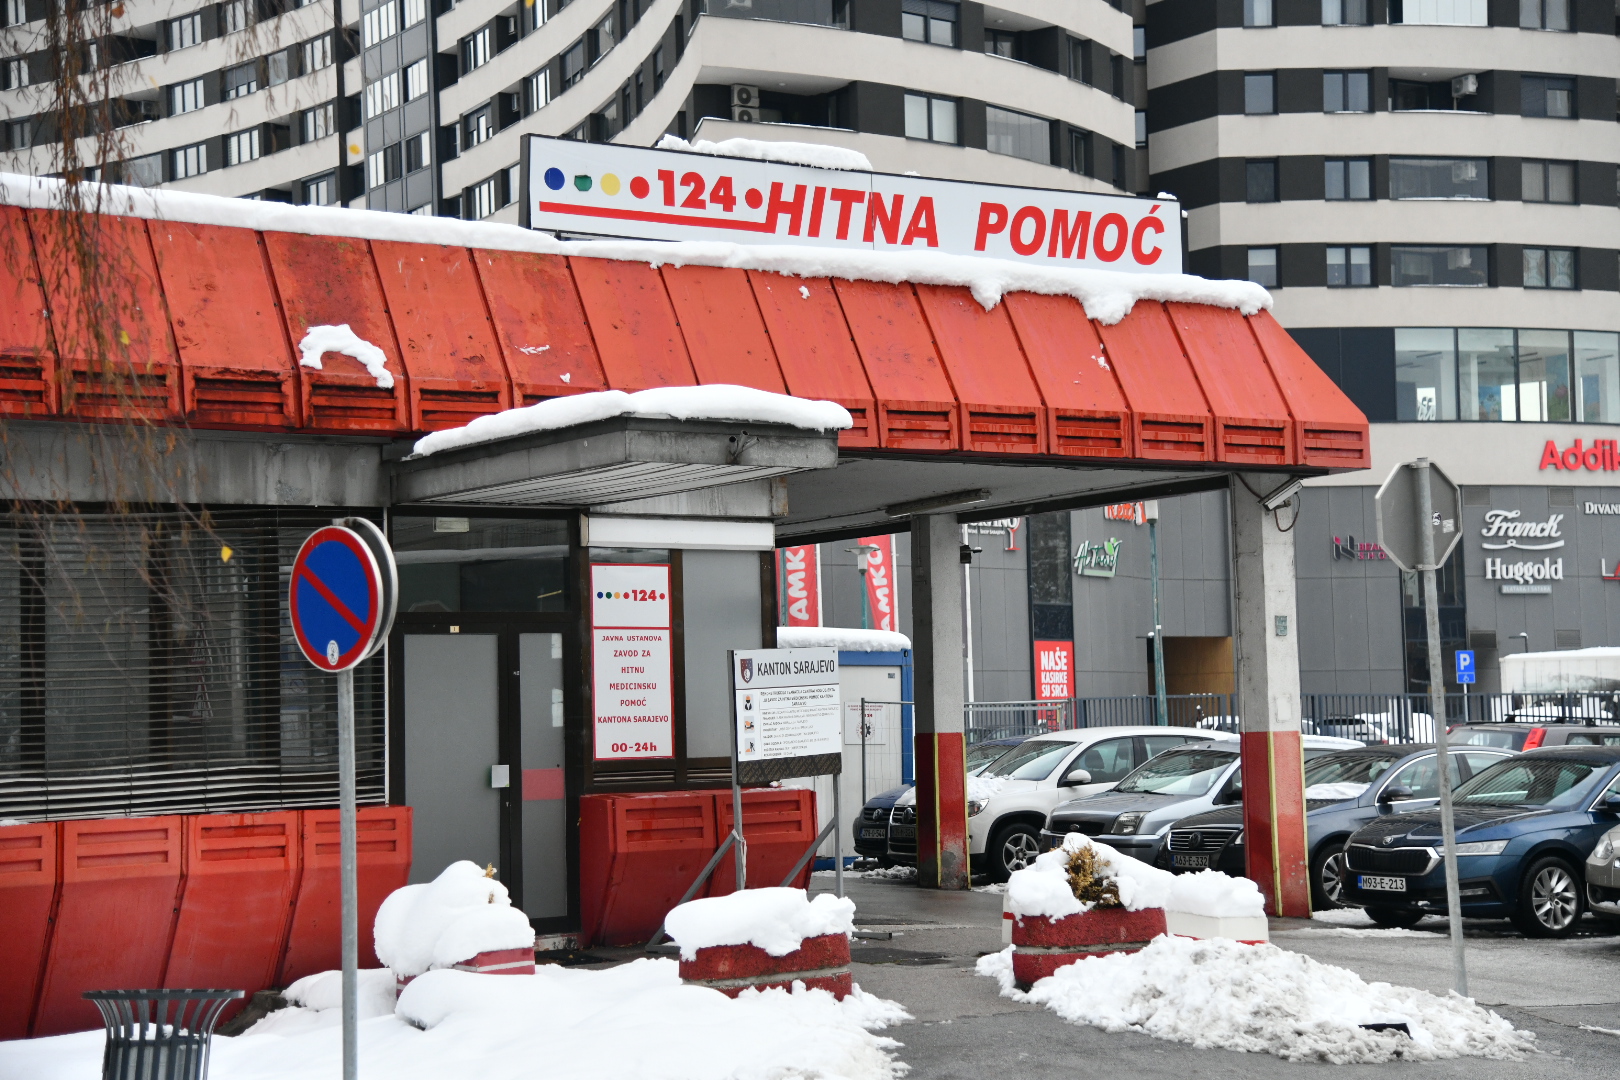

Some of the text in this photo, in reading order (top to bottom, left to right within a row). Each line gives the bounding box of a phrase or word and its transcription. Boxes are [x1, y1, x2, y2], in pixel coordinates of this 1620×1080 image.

[656, 168, 1166, 266] 124 HITNA POMOĆ
[1481, 509, 1564, 537] Franck
[1358, 542, 1384, 551] BEA
[1358, 551, 1387, 560] SHO
[1485, 557, 1564, 584] Huggold
[785, 544, 810, 621] AMK
[631, 589, 658, 602] 124
[613, 649, 651, 658] ZAVOD ZA
[1040, 646, 1068, 671] NAŠE
[757, 659, 835, 676] KANTON SARAJEVO
[1459, 653, 1471, 671] P
[621, 666, 645, 674] HITNU
[1040, 671, 1068, 684] KASIRKE
[609, 682, 657, 690] MEDICINSKU
[1041, 684, 1069, 697] SU SRCA
[620, 697, 647, 707] POMOĆ
[597, 715, 669, 724] KANTONA SARAJEVO
[611, 742, 658, 753] 00-24h
[1174, 855, 1208, 867] A63-E-332
[1362, 877, 1405, 890] M93-E-213
